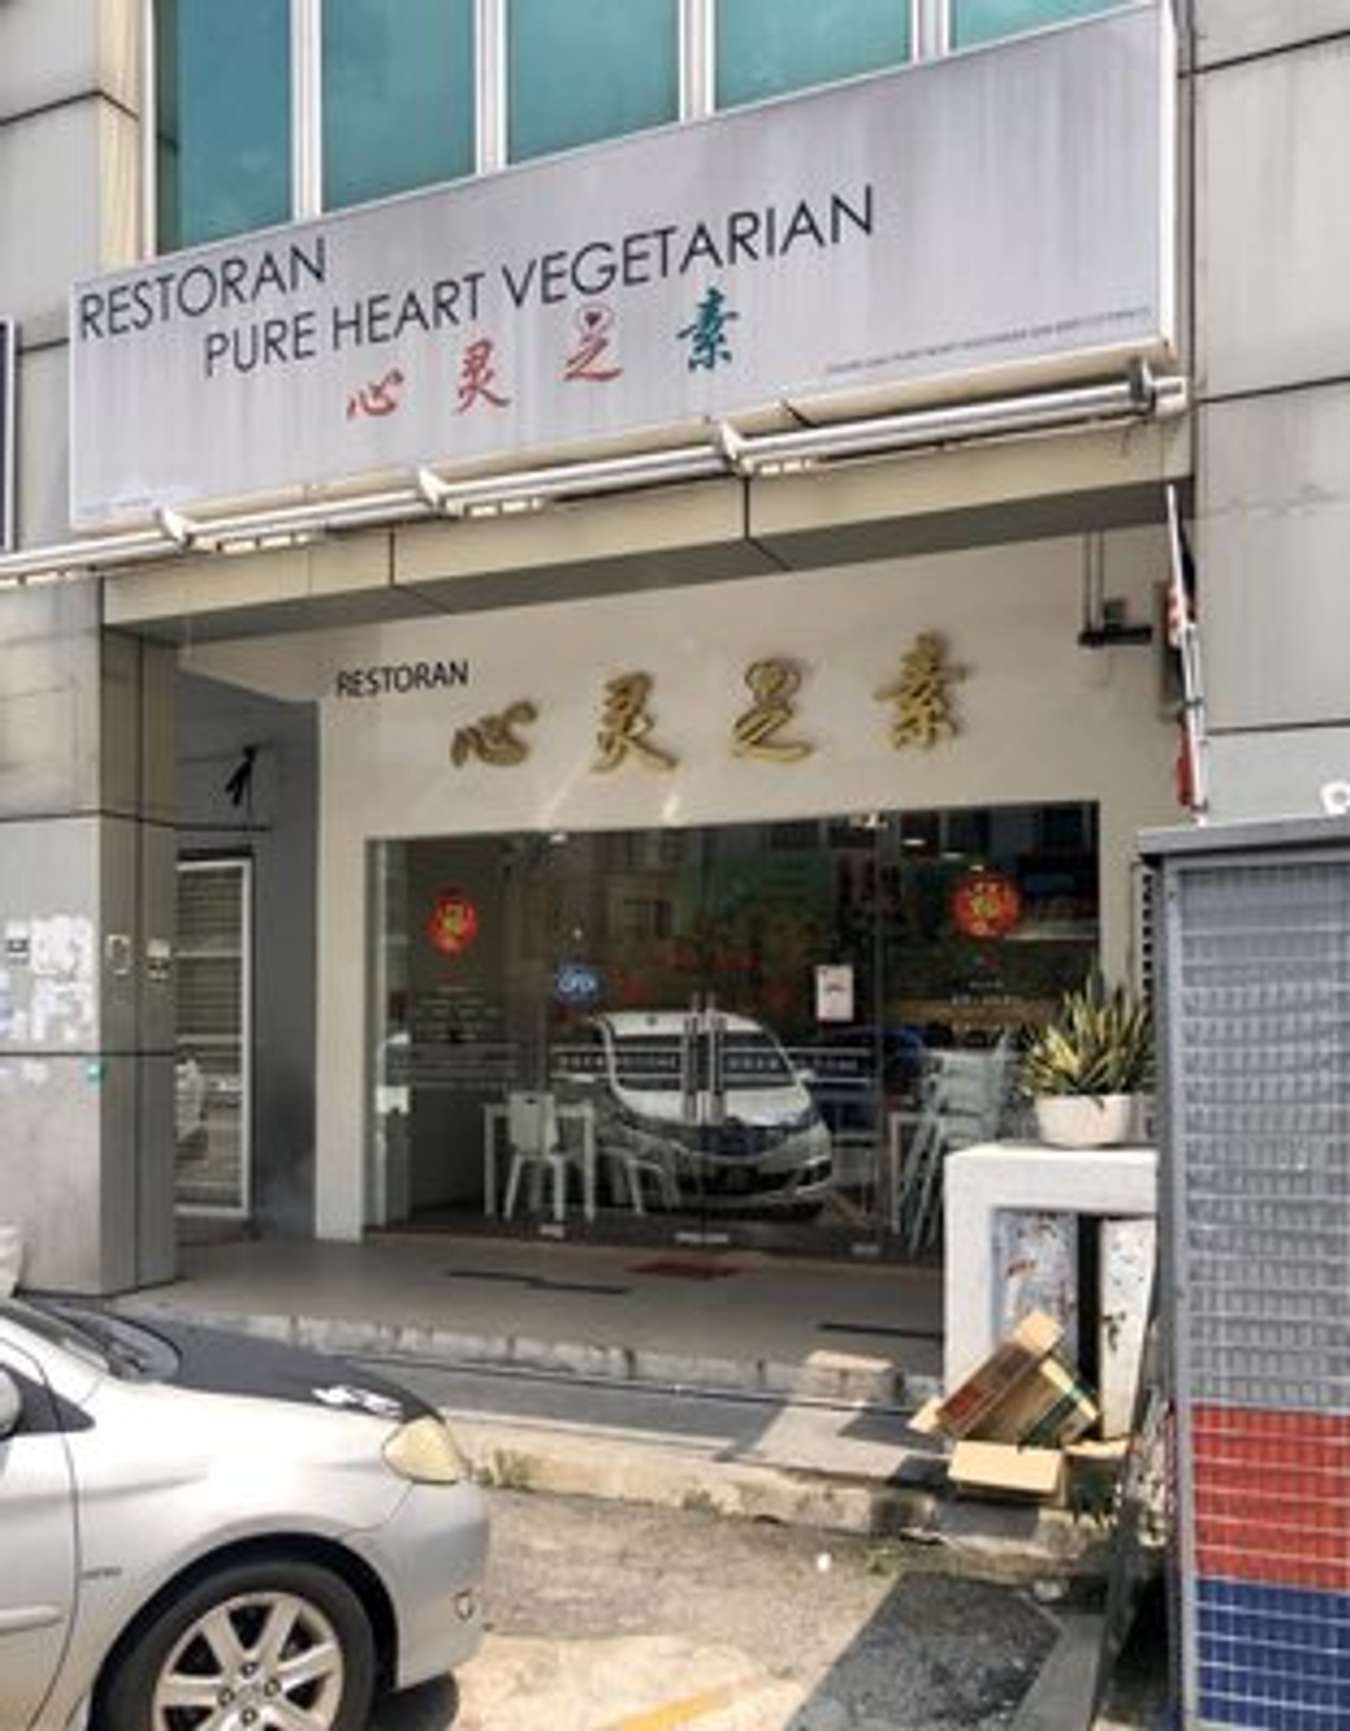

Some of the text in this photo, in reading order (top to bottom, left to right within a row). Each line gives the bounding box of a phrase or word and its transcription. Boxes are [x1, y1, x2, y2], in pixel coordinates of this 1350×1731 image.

[80, 237, 326, 340] RESTORAN
[205, 184, 873, 377] PURE HEART VEGETARIAN
[346, 285, 740, 420] 心灵之素
[336, 660, 469, 699] RESTORAN
[450, 631, 973, 774] 心灵之素
